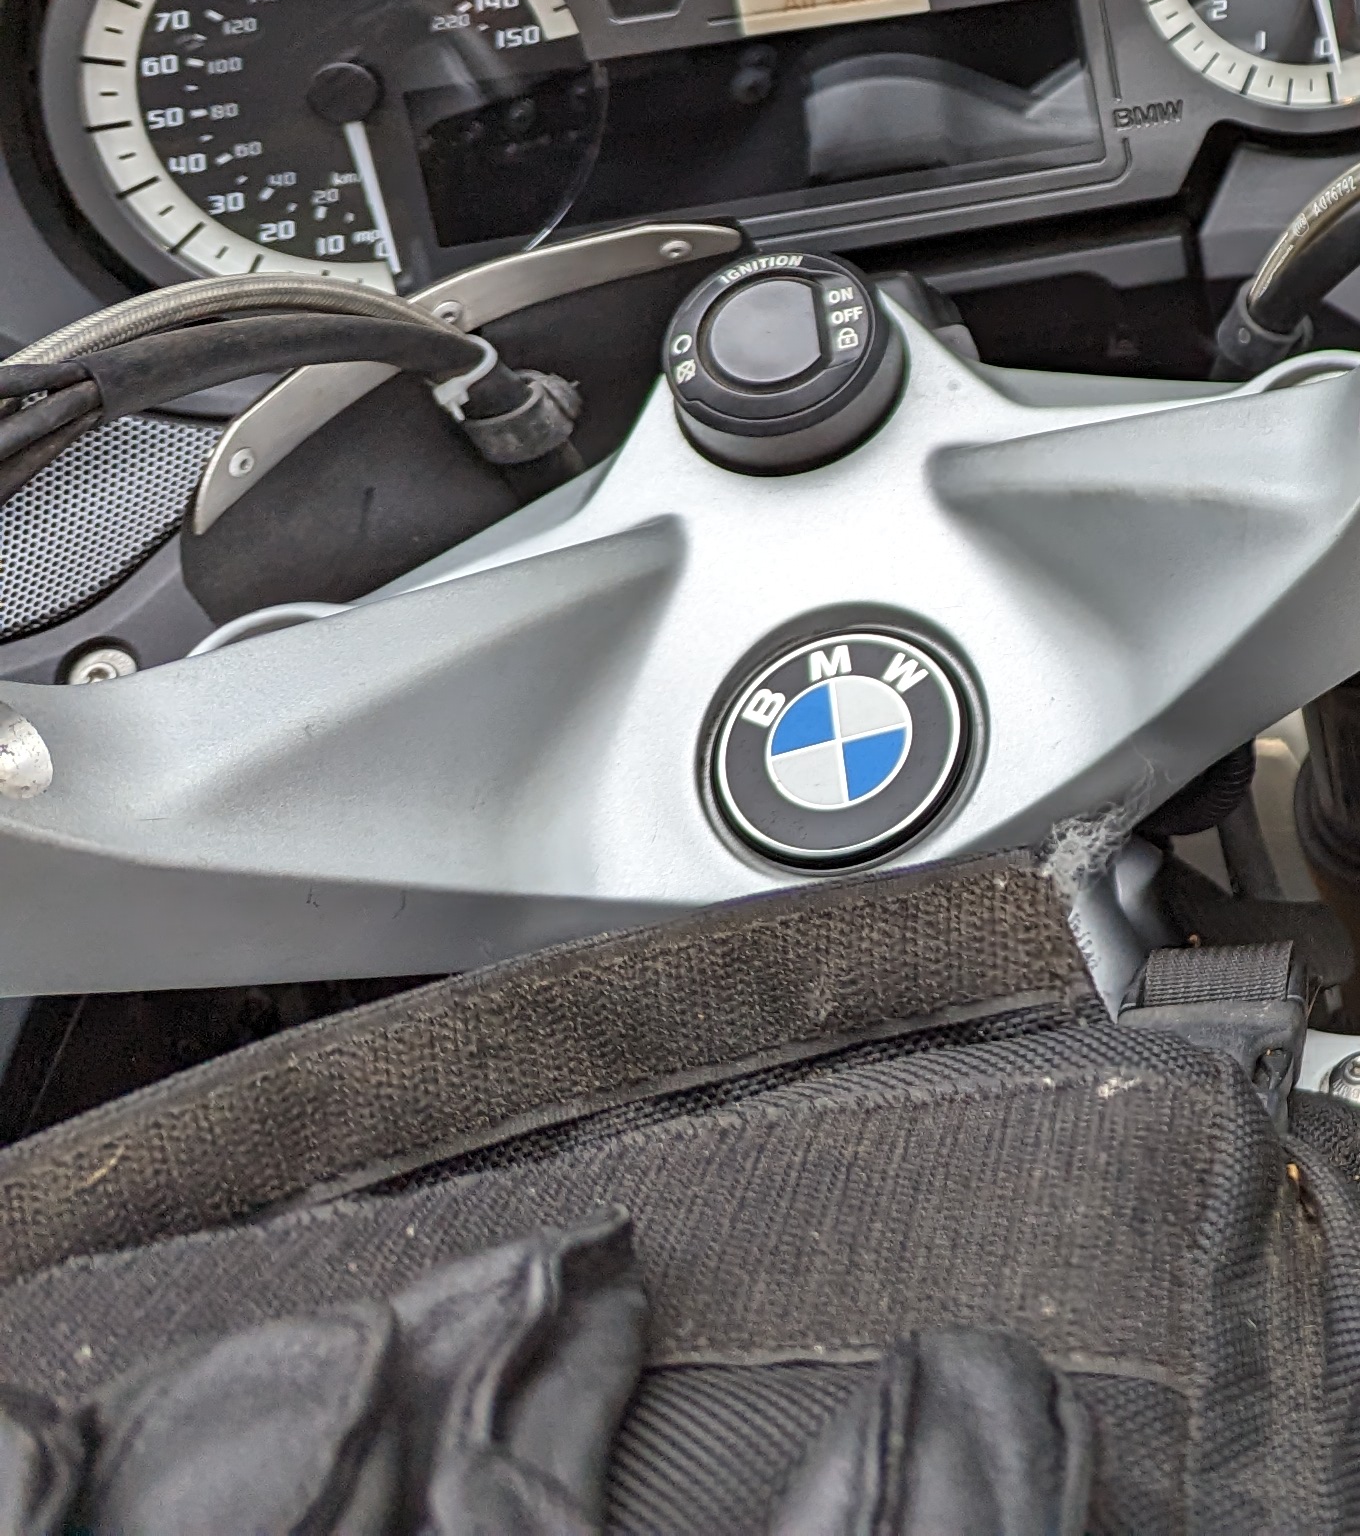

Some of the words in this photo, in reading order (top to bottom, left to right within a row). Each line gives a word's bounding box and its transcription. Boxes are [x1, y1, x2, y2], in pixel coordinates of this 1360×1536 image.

[155, 10, 190, 32] 70
[1207, 0, 1228, 21] 2
[223, 17, 257, 35] 120
[431, 14, 470, 32] 220
[495, 25, 540, 49] 150
[1255, 30, 1266, 51] 1
[141, 54, 179, 77] 60
[207, 56, 243, 74] 100
[147, 106, 184, 130] 50
[210, 102, 239, 121] 80
[1113, 98, 1183, 130] BMW
[168, 153, 207, 175] 40
[267, 171, 297, 187] 40
[207, 192, 245, 215] 30
[312, 188, 339, 204] 20
[258, 220, 296, 243] 20
[315, 234, 345, 257] 10
[719, 255, 803, 284] IGNITION
[828, 287, 854, 304] ON
[831, 306, 863, 325] OFF
[742, 644, 929, 727] BMW
